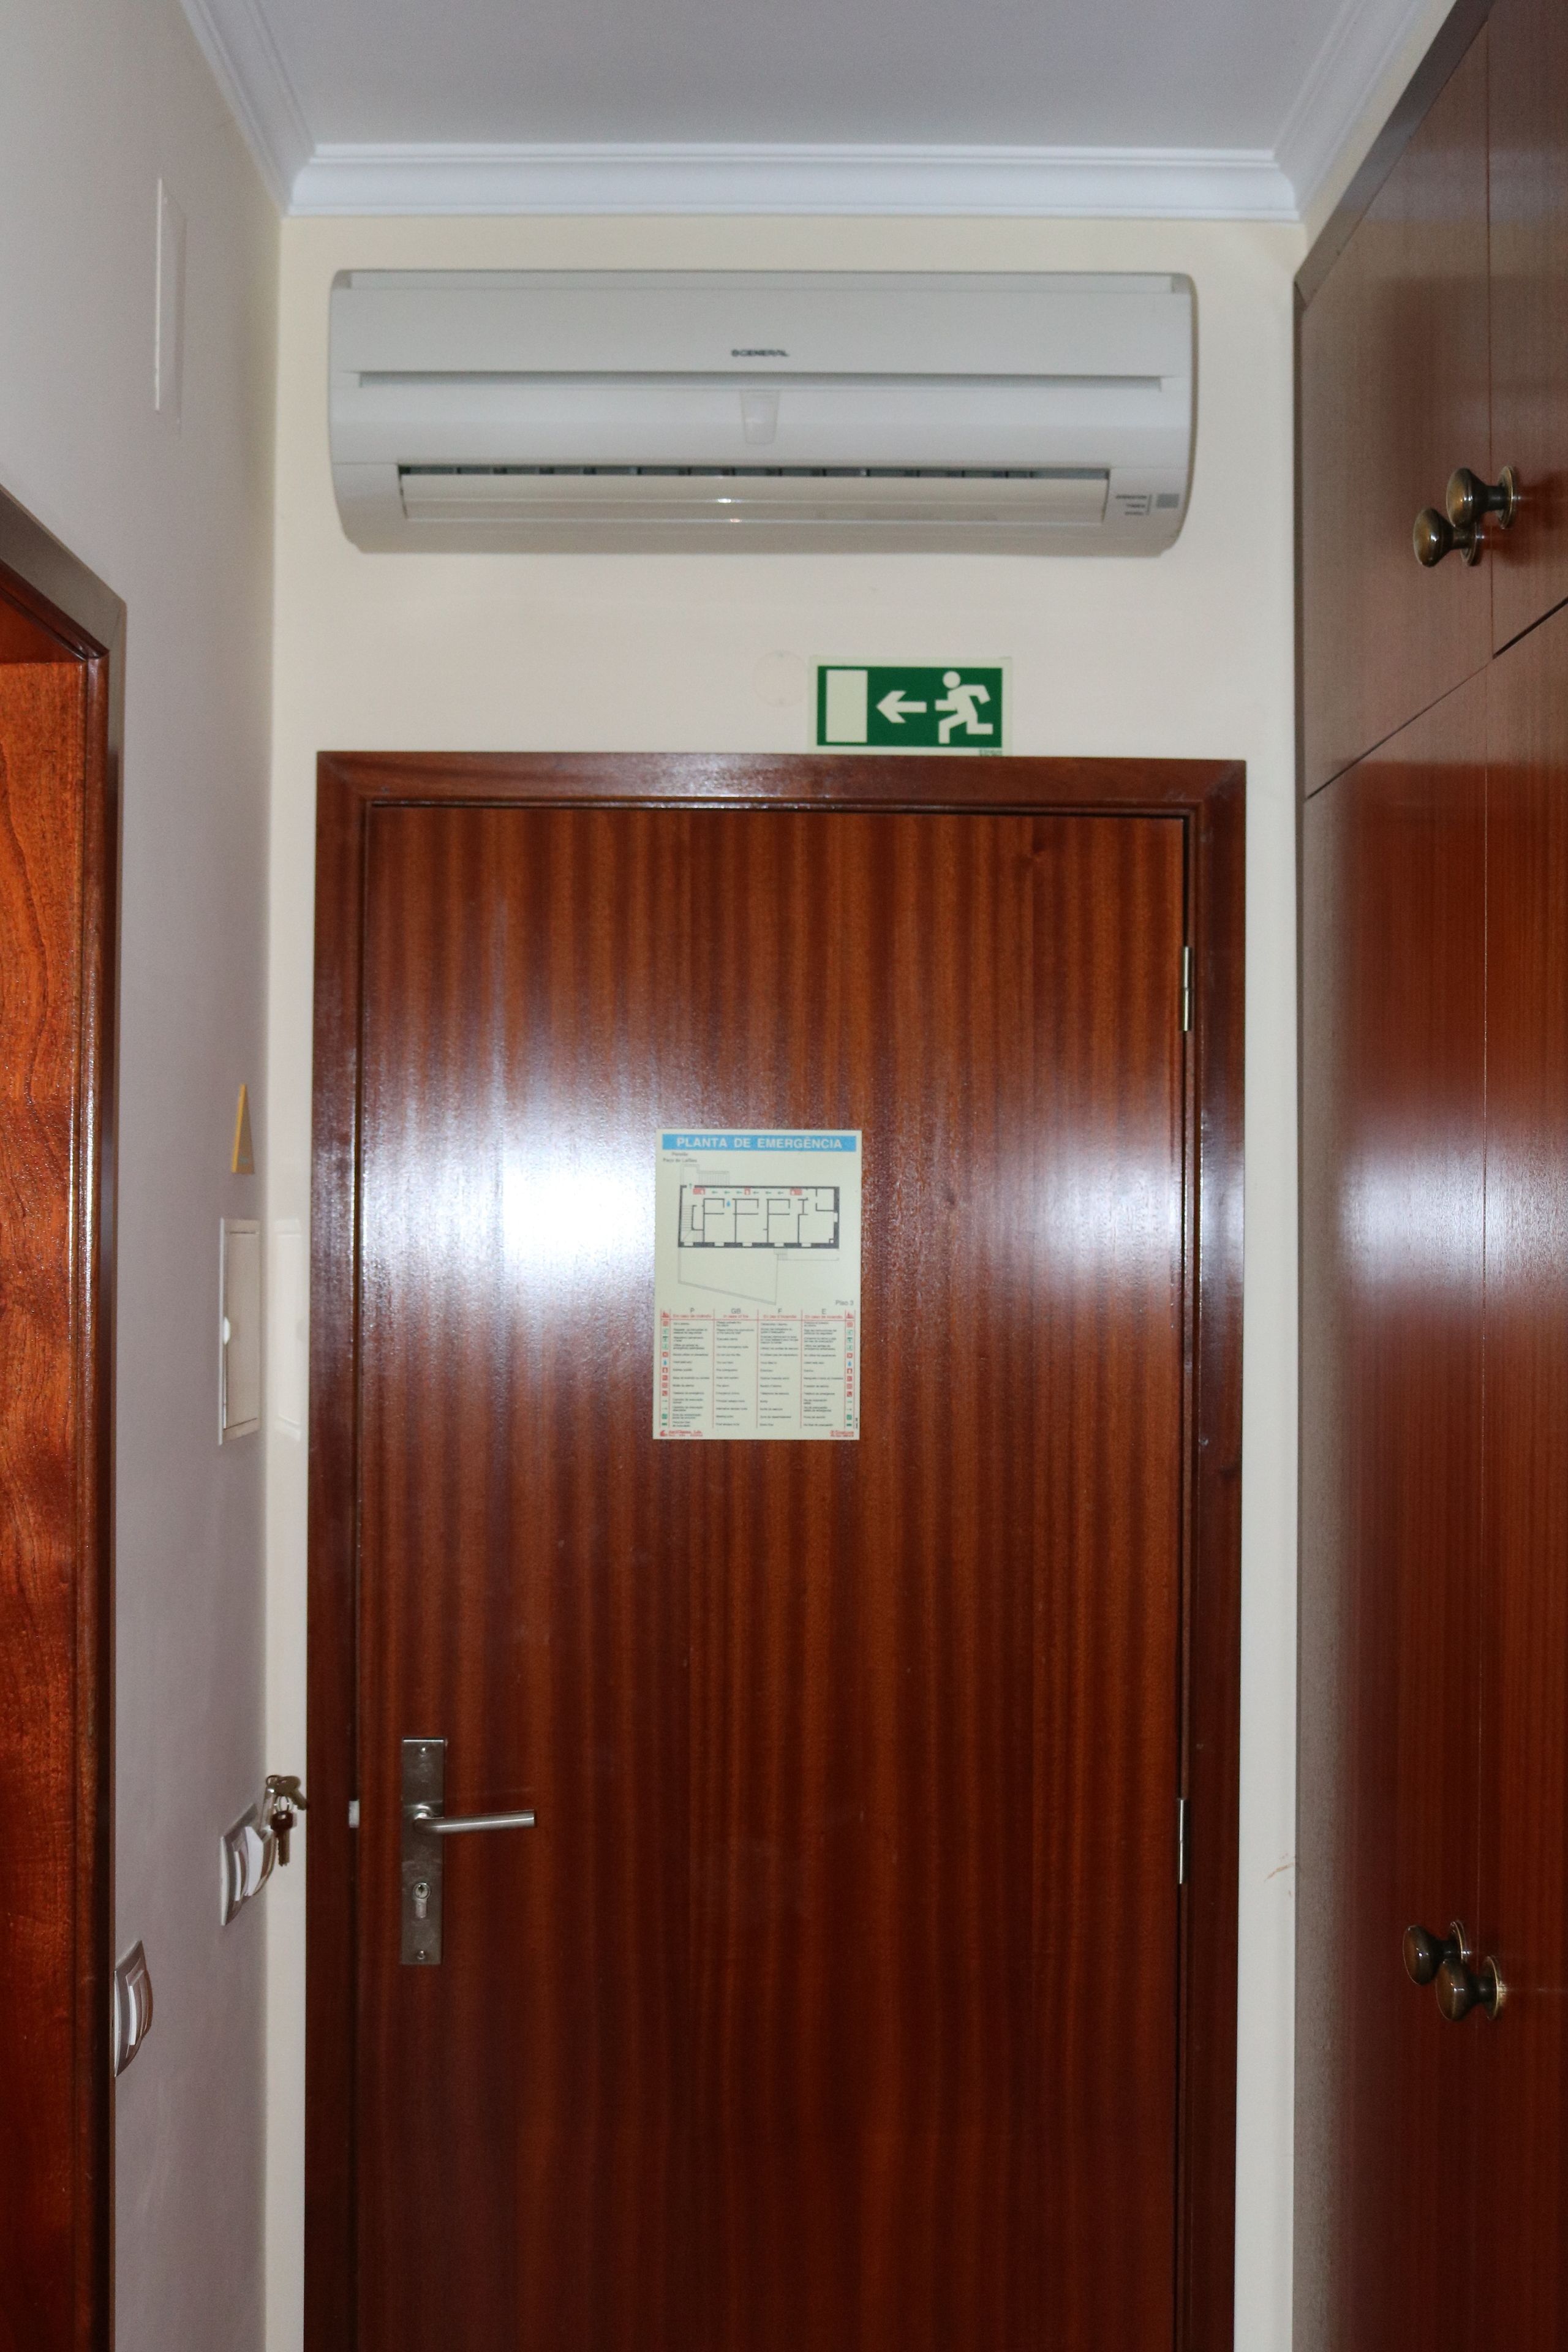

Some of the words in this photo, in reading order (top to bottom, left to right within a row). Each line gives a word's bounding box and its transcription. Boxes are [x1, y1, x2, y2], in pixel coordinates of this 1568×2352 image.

[676, 1137, 728, 1147] PLANTA
[734, 1138, 751, 1148] DE
[756, 1136, 843, 1149] EMERGÊNCIA
